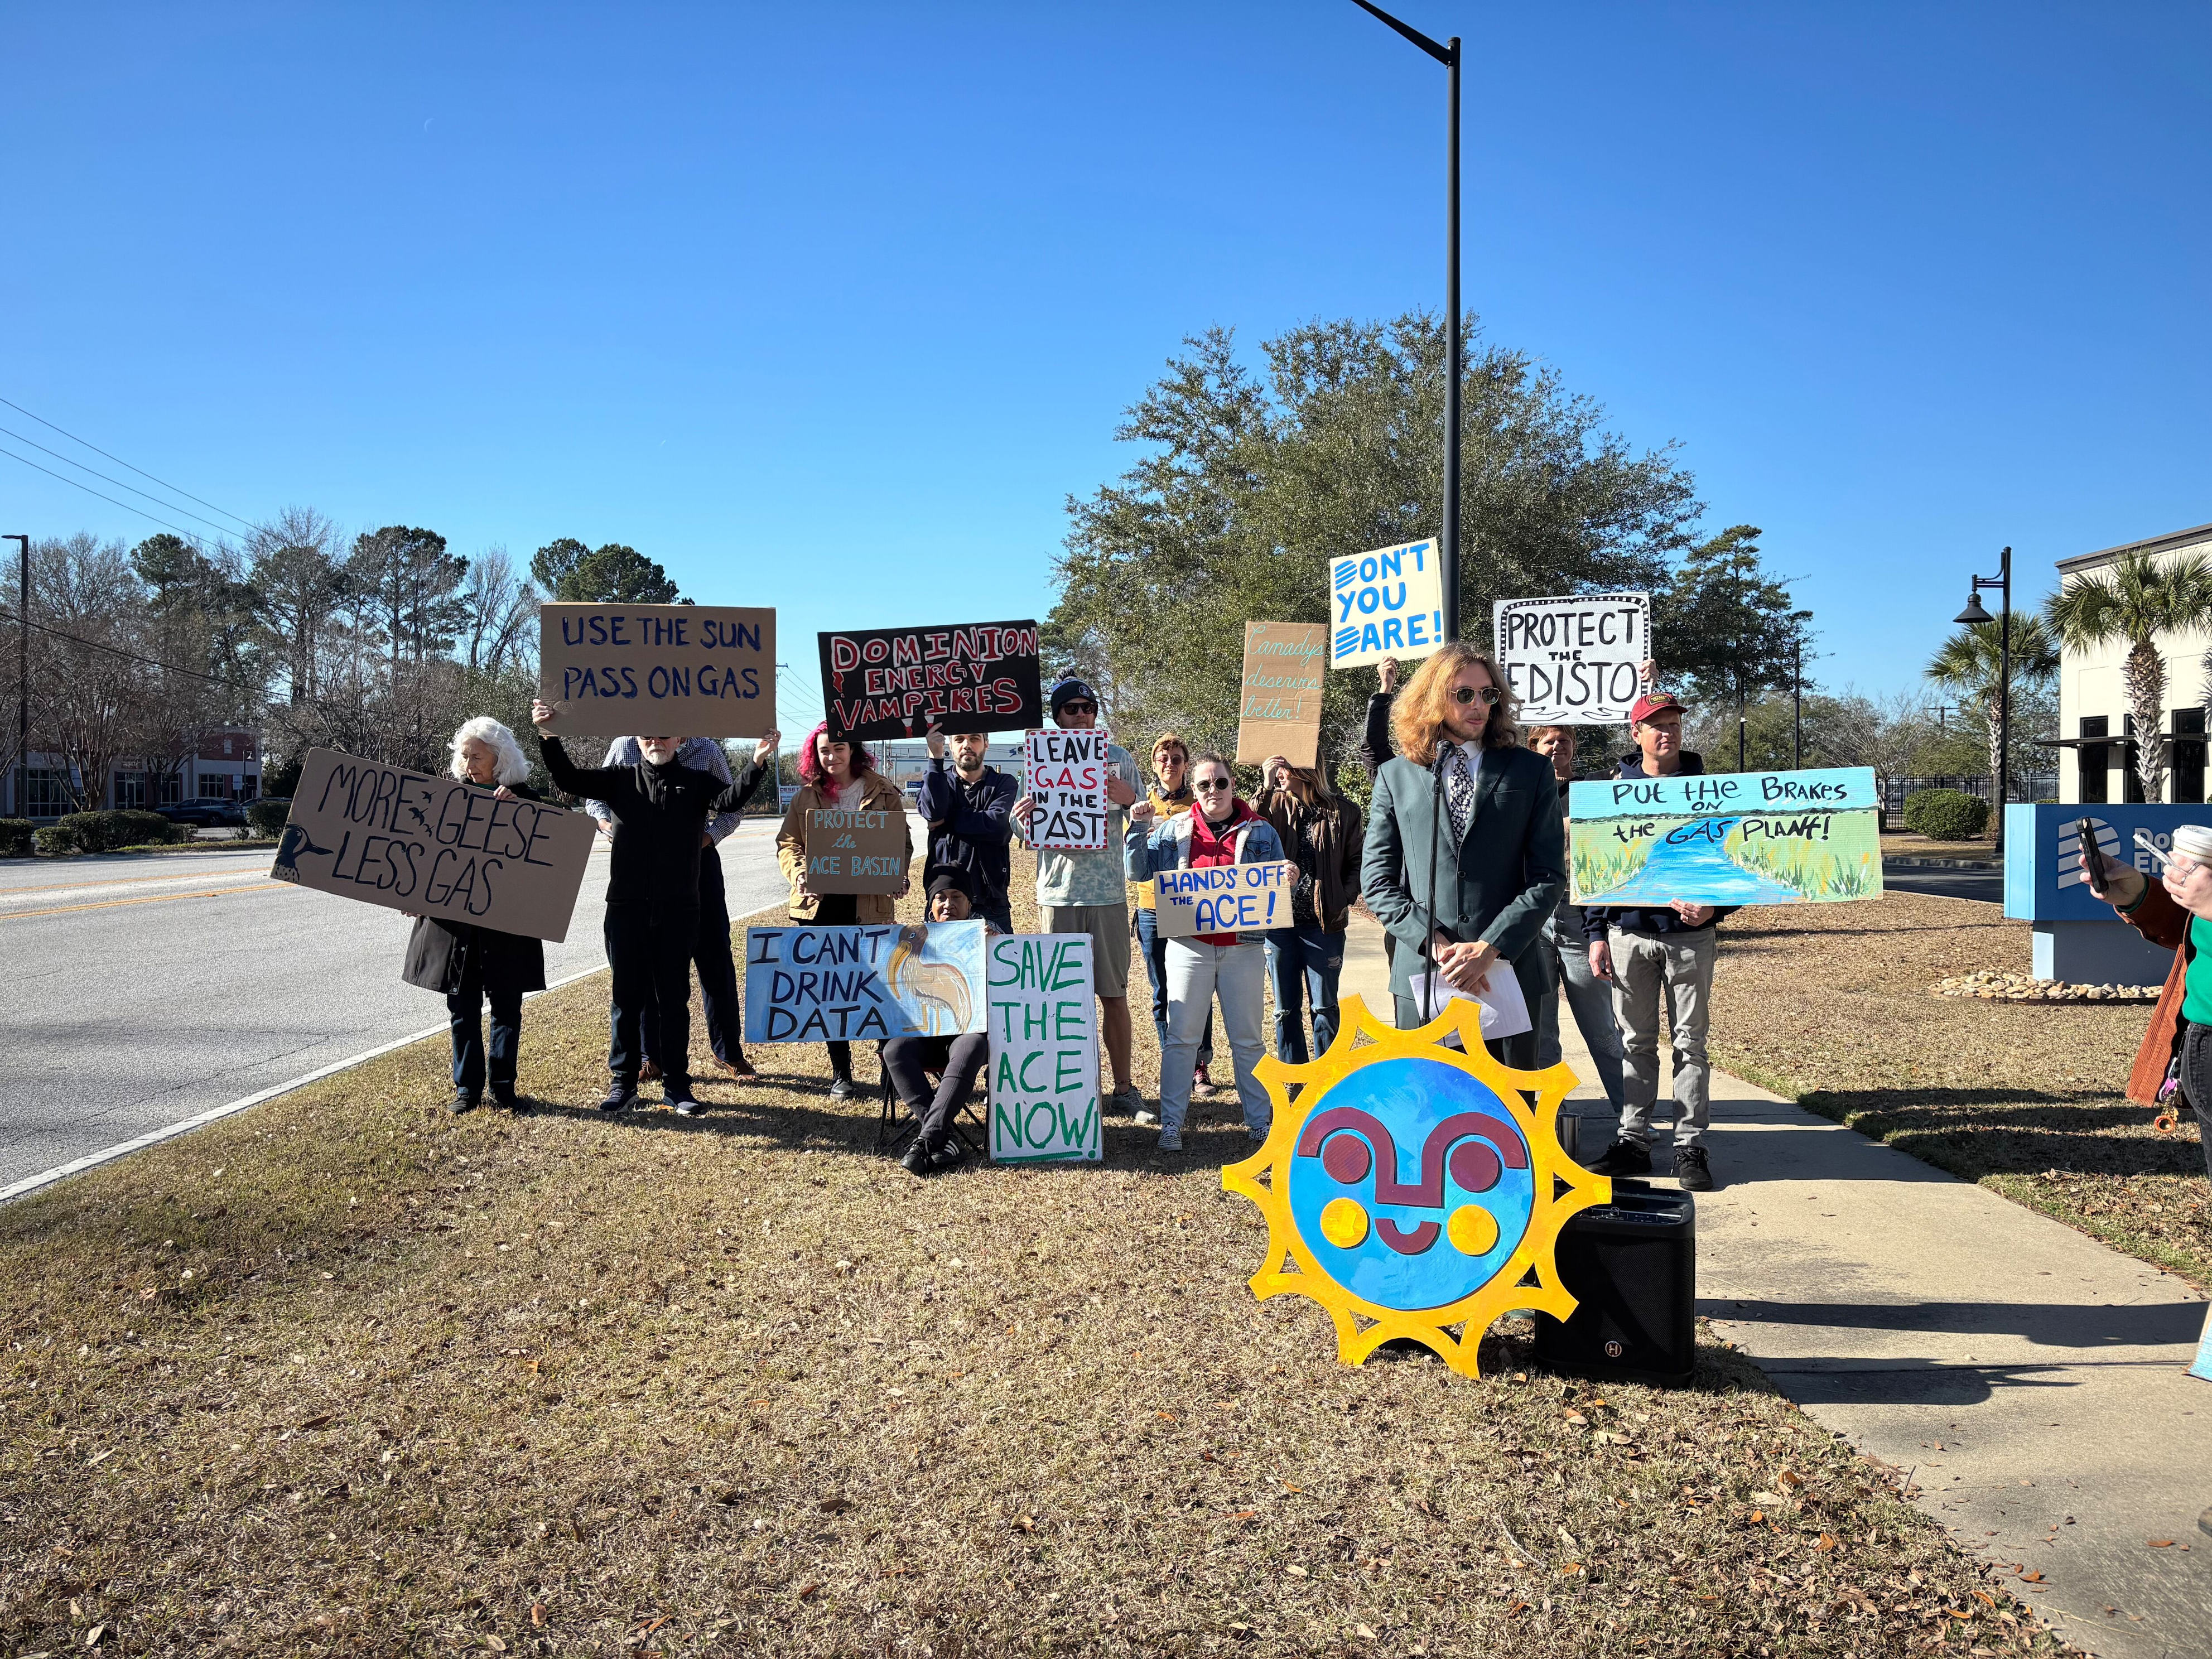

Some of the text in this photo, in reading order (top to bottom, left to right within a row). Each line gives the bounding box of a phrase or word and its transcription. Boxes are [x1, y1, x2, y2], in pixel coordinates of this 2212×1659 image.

[1335, 542, 1429, 591] DON'T
[1336, 582, 1406, 623] YOU
[562, 616, 762, 652] USE THE SUN
[1247, 625, 1324, 666] Canadys
[1508, 609, 1639, 650] PROTECT
[831, 626, 1038, 672] DOMINION
[1548, 650, 1582, 661] THE
[564, 664, 760, 700] PASS ON GAS
[1245, 662, 1323, 688] deserves
[1507, 662, 1637, 706] EDISTO
[833, 678, 1023, 730] VAMPIRES
[1241, 695, 1302, 719] better!
[1034, 737, 1104, 764] LEAVE
[1035, 765, 1097, 790] GAS
[318, 763, 563, 866] MORE GEESE
[1032, 791, 1097, 808] IN THE
[815, 811, 889, 829] PROTECT
[1029, 808, 1104, 842] PAST
[1665, 820, 1733, 844] GAS
[831, 833, 856, 848] the
[331, 831, 503, 916] LESS GAS
[808, 856, 900, 876] ACE BASIN
[1159, 865, 1284, 894] HANDS OFF
[1170, 891, 1276, 931] THE ACE!
[749, 928, 890, 964] I CAN'T
[988, 939, 1086, 992] SAVE
[772, 970, 884, 1005] DRINK
[768, 1005, 888, 1040] DATA
[991, 1001, 1087, 1043] THE
[997, 1051, 1083, 1094] ACE
[996, 1097, 1098, 1159] NOW!
